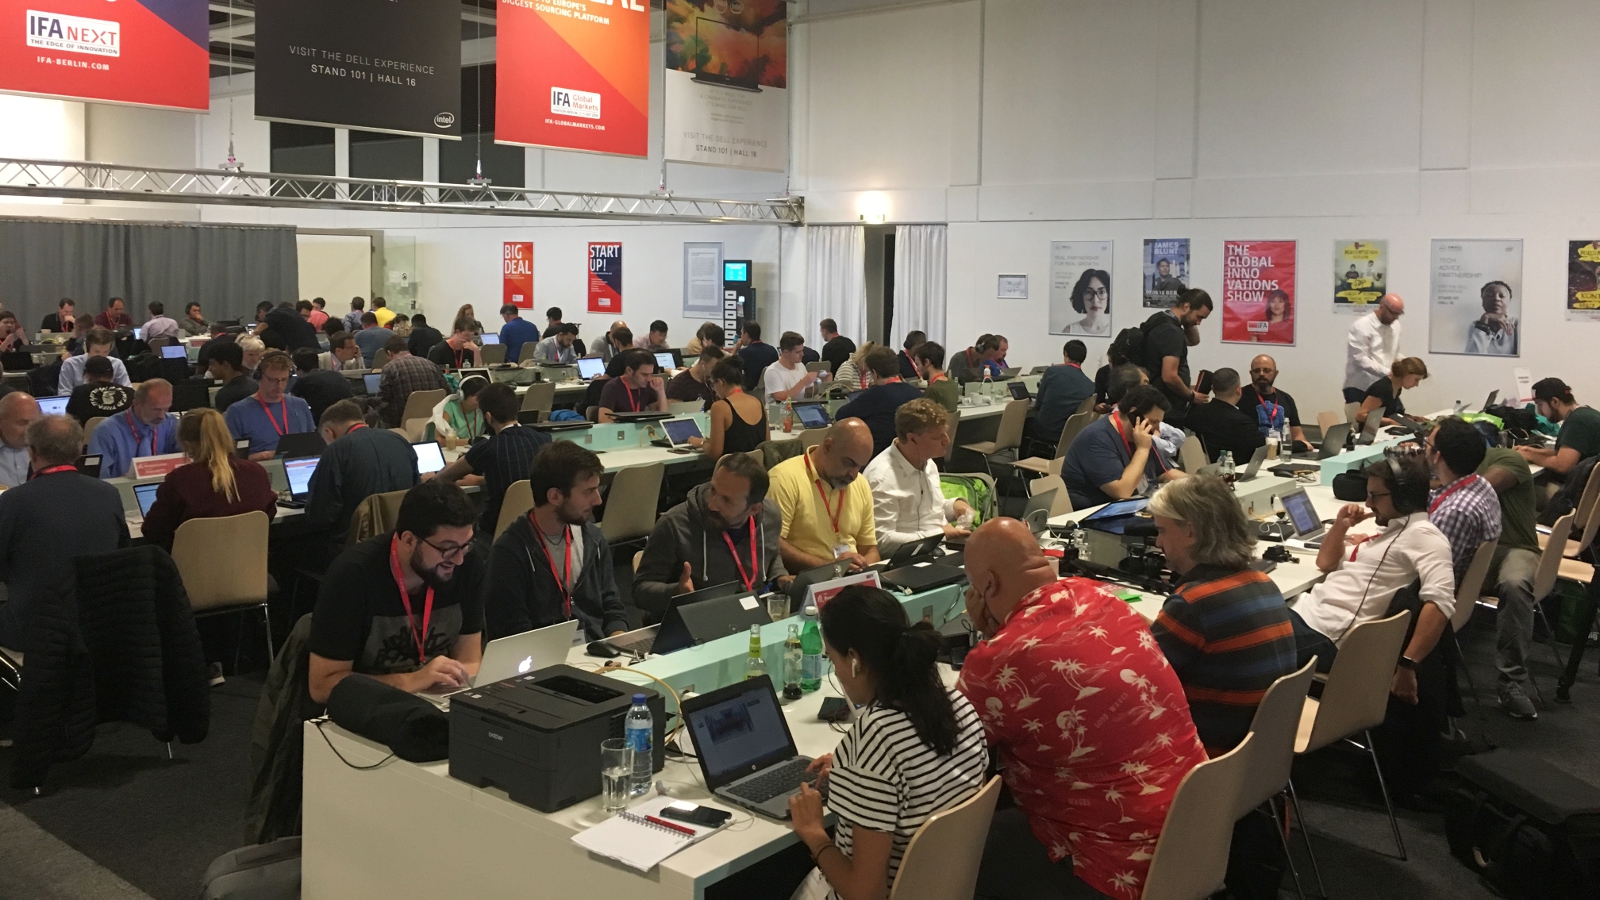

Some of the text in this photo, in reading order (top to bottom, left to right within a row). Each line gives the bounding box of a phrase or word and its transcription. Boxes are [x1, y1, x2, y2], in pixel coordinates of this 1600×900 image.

[553, 0, 587, 11] EUROPE'S
[535, 4, 572, 17] SOURCING
[573, 11, 610, 25] PLATFORM
[30, 15, 117, 46] IFA NEXT
[77, 44, 118, 54] INNOVATION
[37, 55, 110, 71] IFA-BERLIN.COM
[289, 45, 435, 75] VISIT THE DELL EXPERIENCE
[310, 64, 347, 77] STAND
[350, 70, 366, 80] 101
[377, 74, 403, 85] HALL
[406, 77, 416, 87] 16
[553, 90, 571, 107] IFA
[572, 94, 593, 103] Global
[572, 102, 599, 111] Markets
[683, 131, 768, 148] VISIT THE DELL EXPERIENCE
[695, 144, 717, 154] STAND
[718, 147, 728, 155] 101
[733, 149, 749, 157] HALL
[504, 244, 522, 259] BIG
[589, 244, 620, 258] START
[1154, 241, 1179, 249] JAMES
[1227, 244, 1250, 256] THE
[504, 259, 532, 275] DEAL
[589, 258, 607, 272] UP!
[1227, 256, 1275, 268] GLOBAL
[1227, 267, 1260, 279] INNO
[1226, 279, 1279, 291] VATIONS
[1227, 290, 1265, 302] SHOW
[1108, 692, 1129, 713] WAVES
[1067, 798, 1091, 806] WAVES
